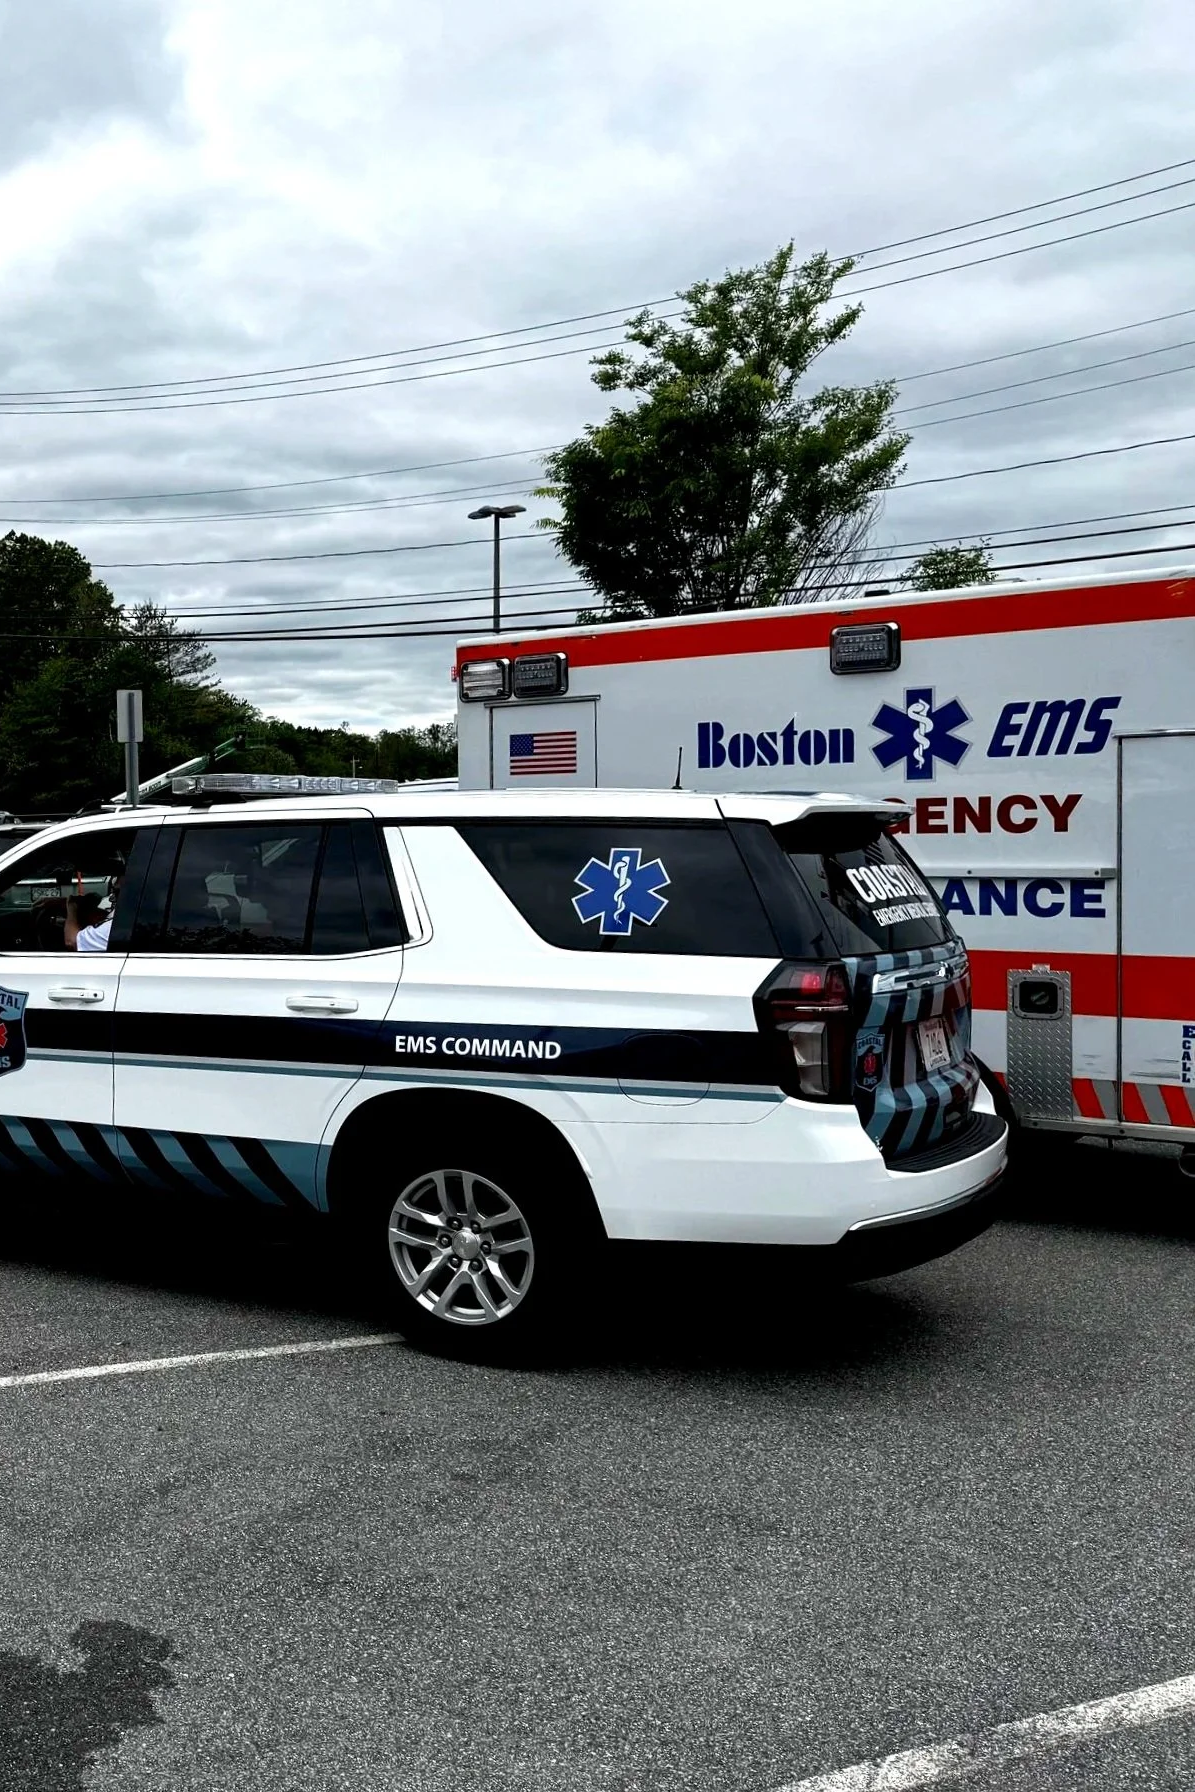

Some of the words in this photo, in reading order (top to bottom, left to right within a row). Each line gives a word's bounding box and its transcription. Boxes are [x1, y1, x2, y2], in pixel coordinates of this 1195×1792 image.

[697, 715, 855, 769] Boston
[986, 695, 1123, 758] EMS
[846, 864, 928, 903] COASTAL
[940, 878, 1107, 919] ANCE
[395, 1035, 436, 1054] EMS
[441, 1037, 562, 1060] COMMAND
